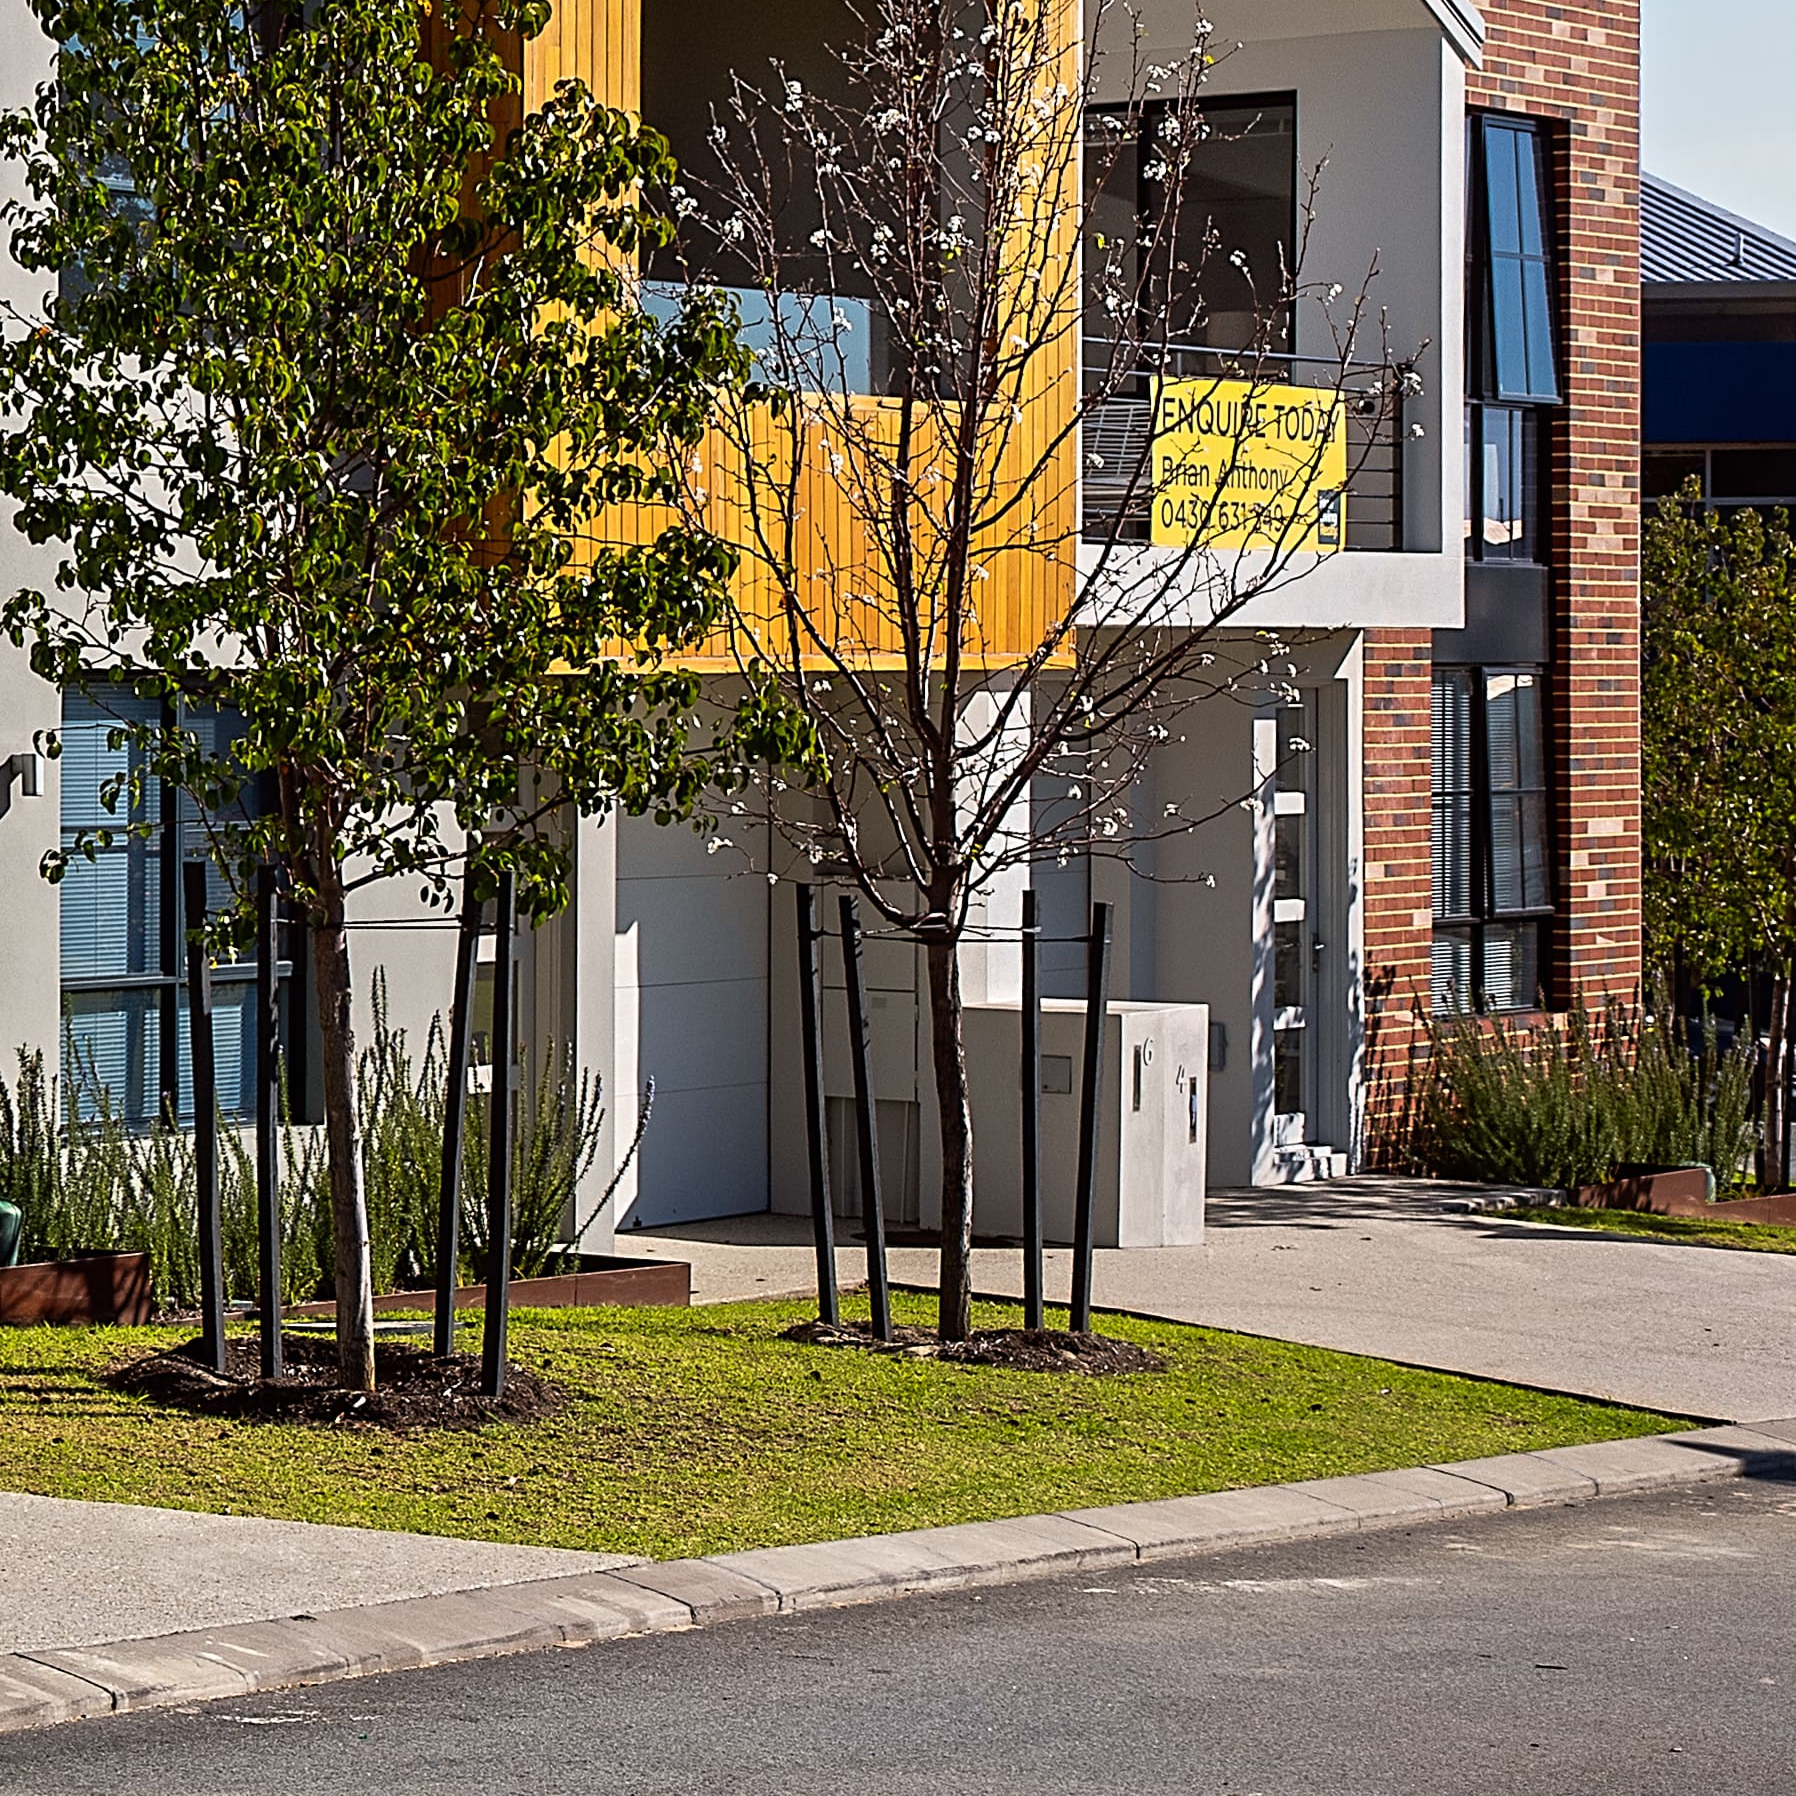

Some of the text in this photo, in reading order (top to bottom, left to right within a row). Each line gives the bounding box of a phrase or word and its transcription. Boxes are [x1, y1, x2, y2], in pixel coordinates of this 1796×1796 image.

[1163, 456, 1288, 491] Brian Anthony
[1161, 499, 1212, 529] 0430
[1219, 501, 1246, 531] 631
[1143, 1037, 1154, 1066] 6
[1175, 1064, 1187, 1093] 4
